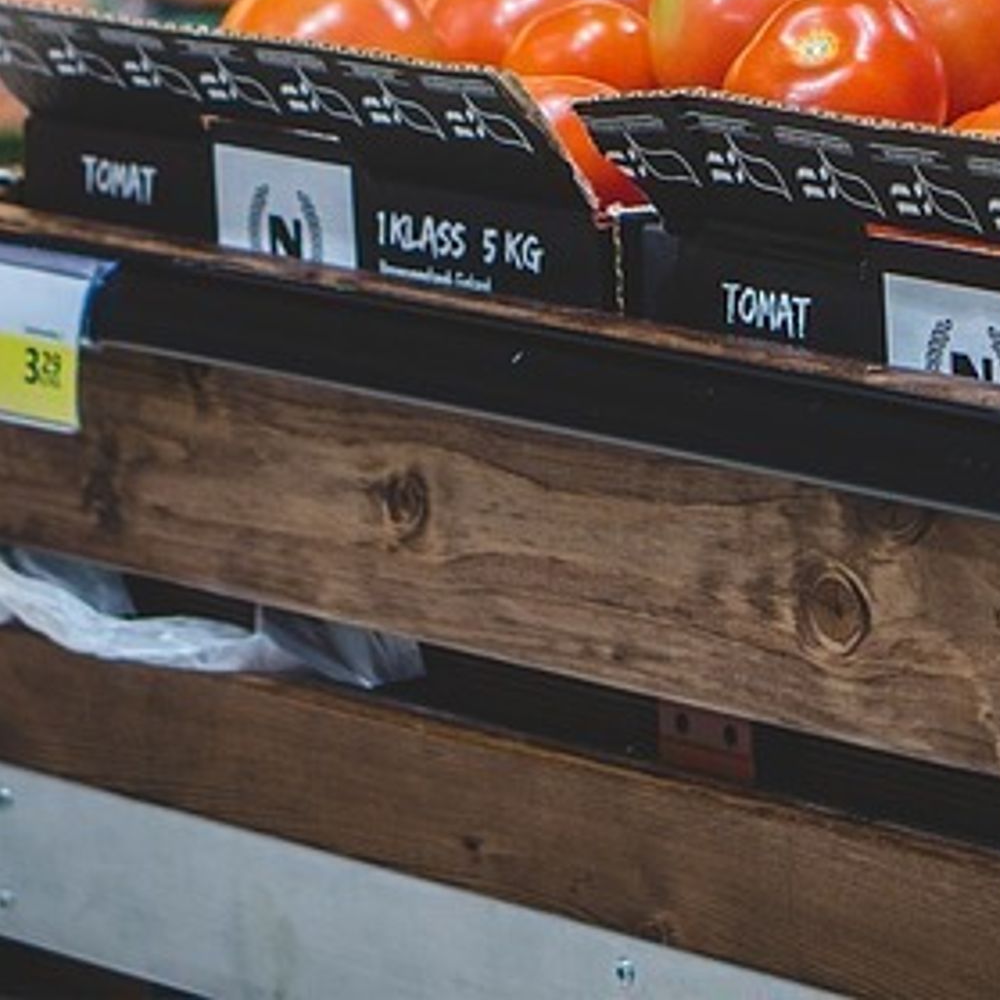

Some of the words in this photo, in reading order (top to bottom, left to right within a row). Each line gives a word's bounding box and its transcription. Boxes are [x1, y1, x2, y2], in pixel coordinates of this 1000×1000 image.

[82, 154, 158, 205] TOMAT
[268, 213, 302, 259] N
[389, 211, 468, 260] KLASS
[482, 228, 499, 265] 5
[504, 230, 546, 275] KG
[721, 282, 811, 339] TOMAT
